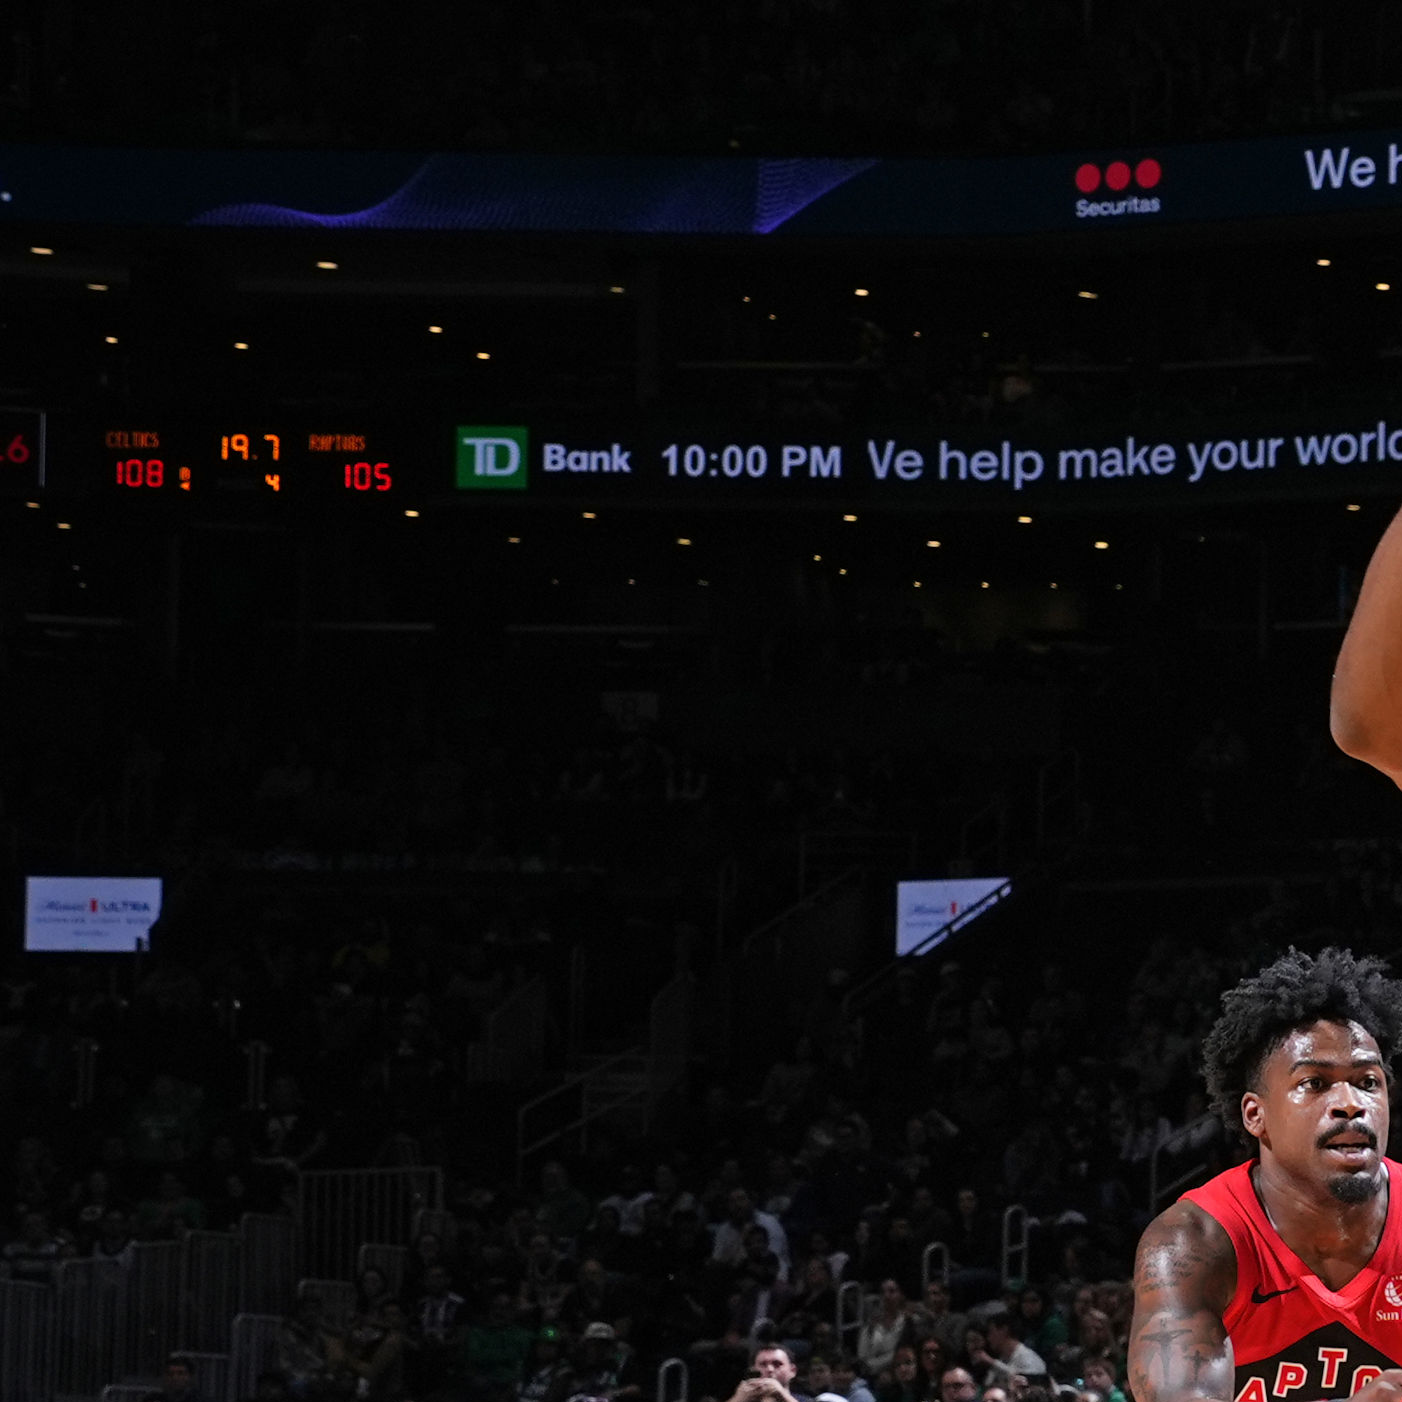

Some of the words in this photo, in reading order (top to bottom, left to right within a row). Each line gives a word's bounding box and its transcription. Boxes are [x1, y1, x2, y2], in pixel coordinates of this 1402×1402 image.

[1304, 147, 1375, 190] We
[1075, 195, 1161, 218] Securitas
[106, 430, 160, 449] CELTICS
[308, 433, 367, 452] RAPTORS
[462, 437, 521, 478] TD
[542, 442, 632, 473] Bank
[661, 444, 768, 478] 10:00
[781, 446, 842, 478] PM
[939, 441, 1044, 490] help
[1059, 437, 1177, 481] make
[1187, 434, 1284, 482] your
[115, 458, 164, 488] 108
[264, 473, 280, 491] 4
[343, 461, 392, 491] 105
[1376, 1308, 1400, 1321] Sun
